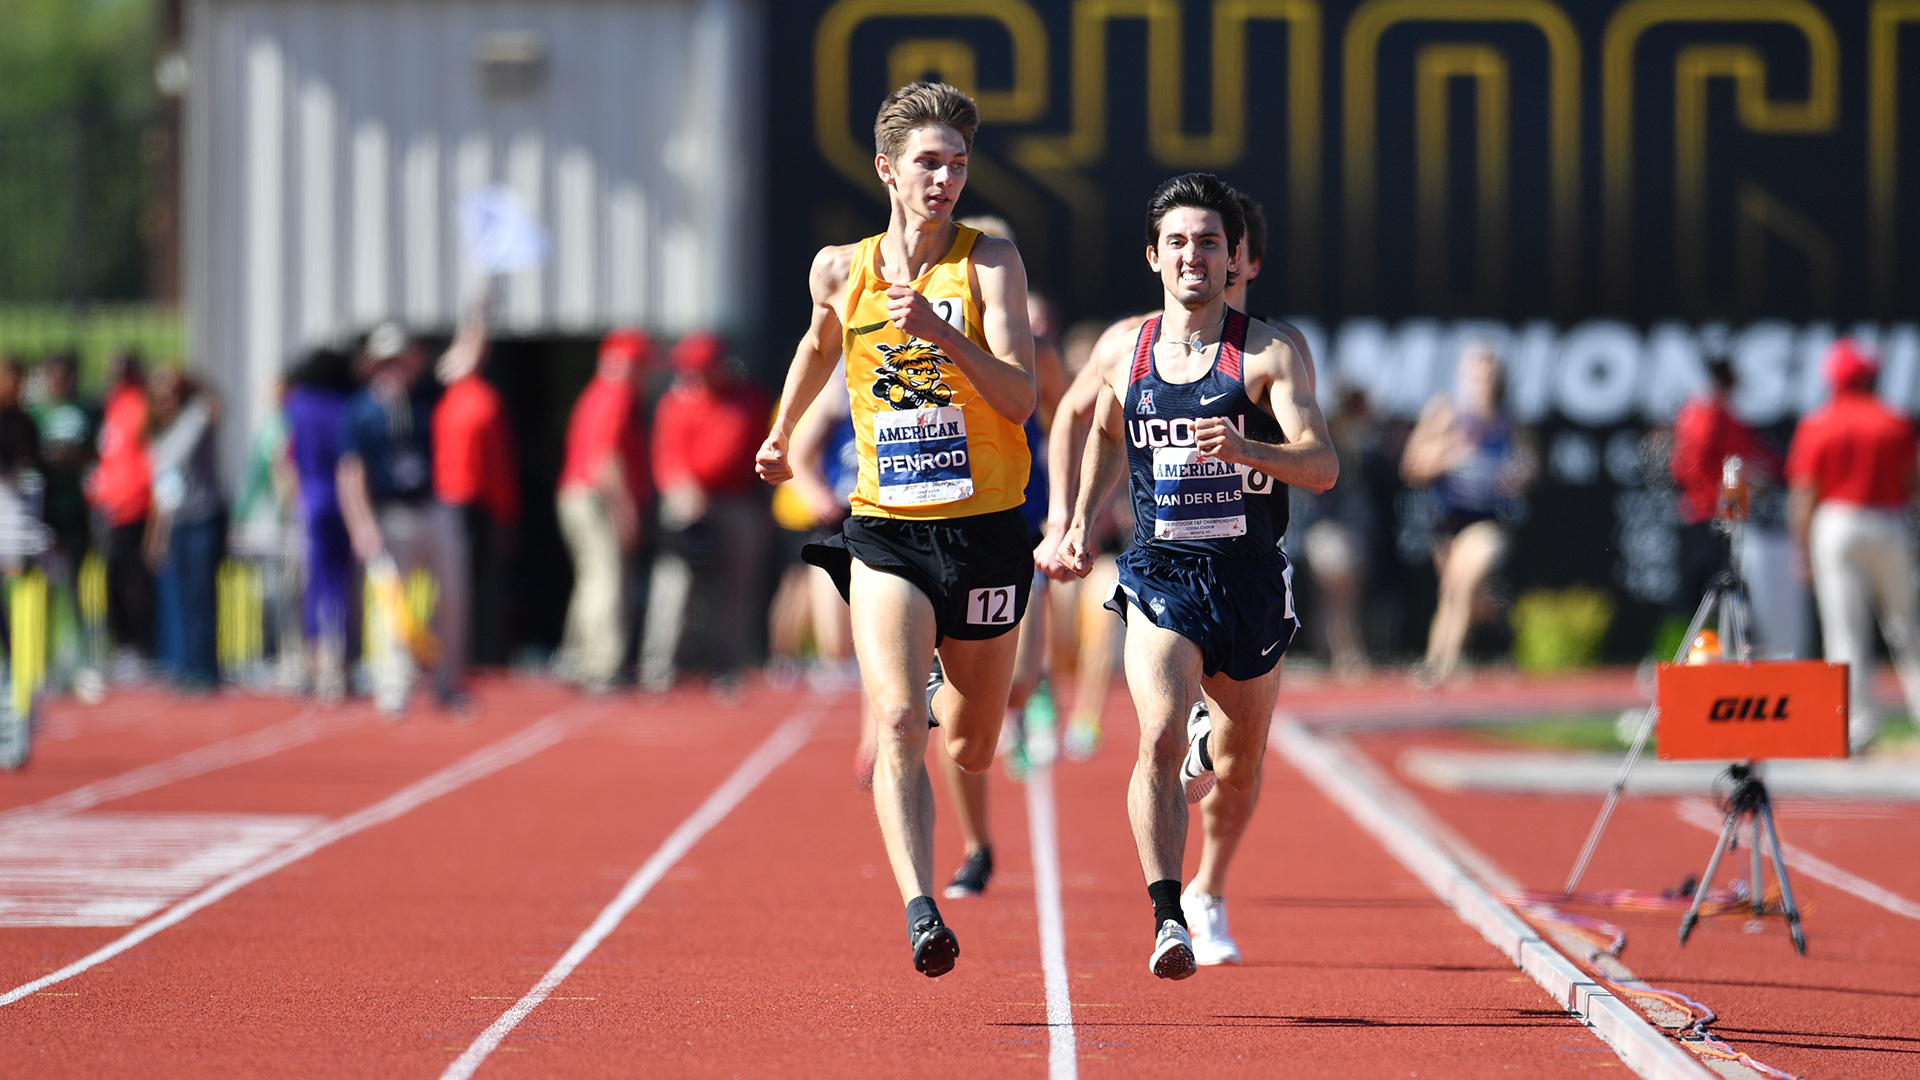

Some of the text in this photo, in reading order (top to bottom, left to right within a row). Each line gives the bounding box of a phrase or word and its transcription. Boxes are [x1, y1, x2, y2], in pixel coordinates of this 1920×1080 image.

[814, 0, 1920, 325] SHOC
[930, 300, 952, 323] 2
[904, 389, 923, 407] WSU
[878, 421, 960, 442] AMERICAN
[1128, 414, 1245, 449] UCON
[878, 449, 967, 474] PENROD
[1156, 461, 1237, 478] AMERICAN
[1154, 490, 1242, 506] VAN DER ELS
[1203, 517, 1239, 525] CHAMPIONSHIPS
[977, 588, 1008, 623] 12
[1708, 695, 1791, 721] GILL
